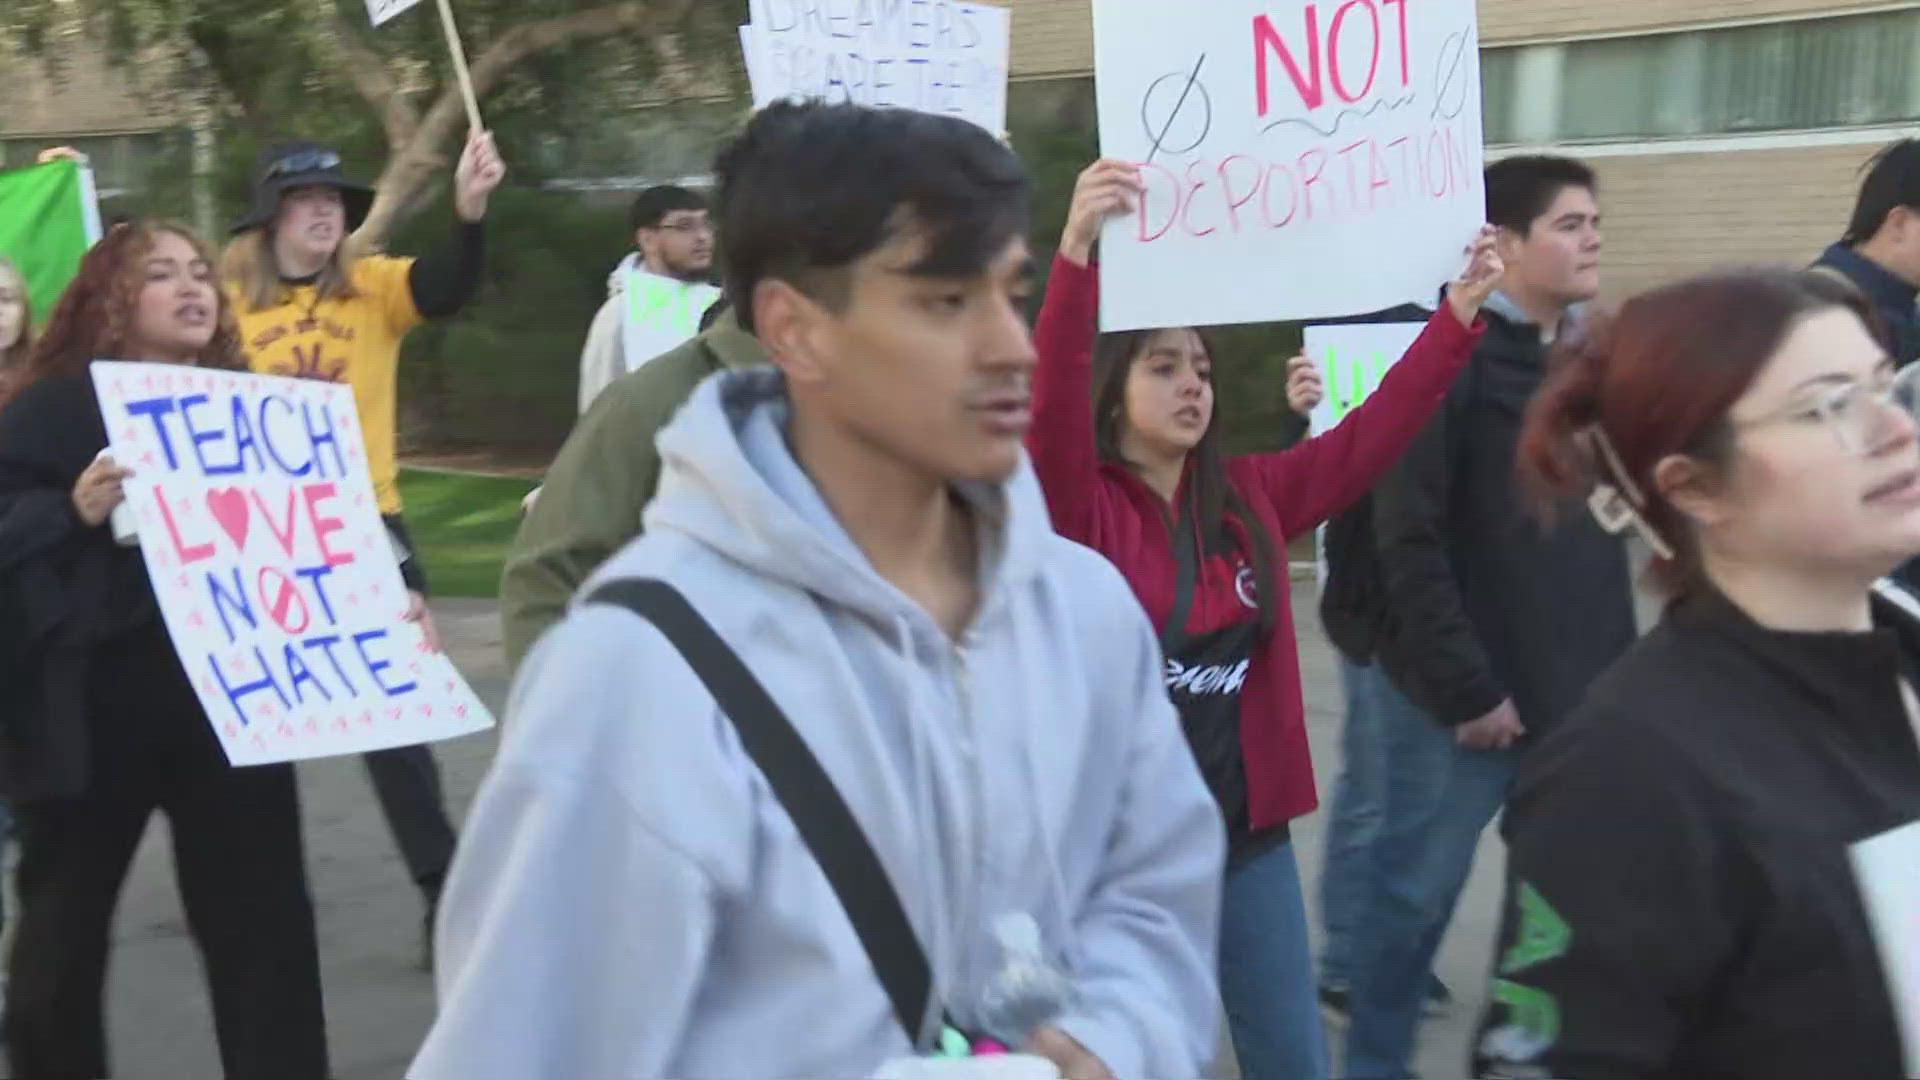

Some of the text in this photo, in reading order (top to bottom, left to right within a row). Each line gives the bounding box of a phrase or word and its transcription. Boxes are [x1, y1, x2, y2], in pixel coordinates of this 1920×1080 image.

[764, 0, 981, 50] DREAMERS
[1253, 0, 1408, 117] NOT
[1137, 126, 1471, 242] DEPORTATION
[125, 393, 347, 479] TEACH
[206, 564, 338, 643] NOT
[209, 629, 417, 726] HATE
